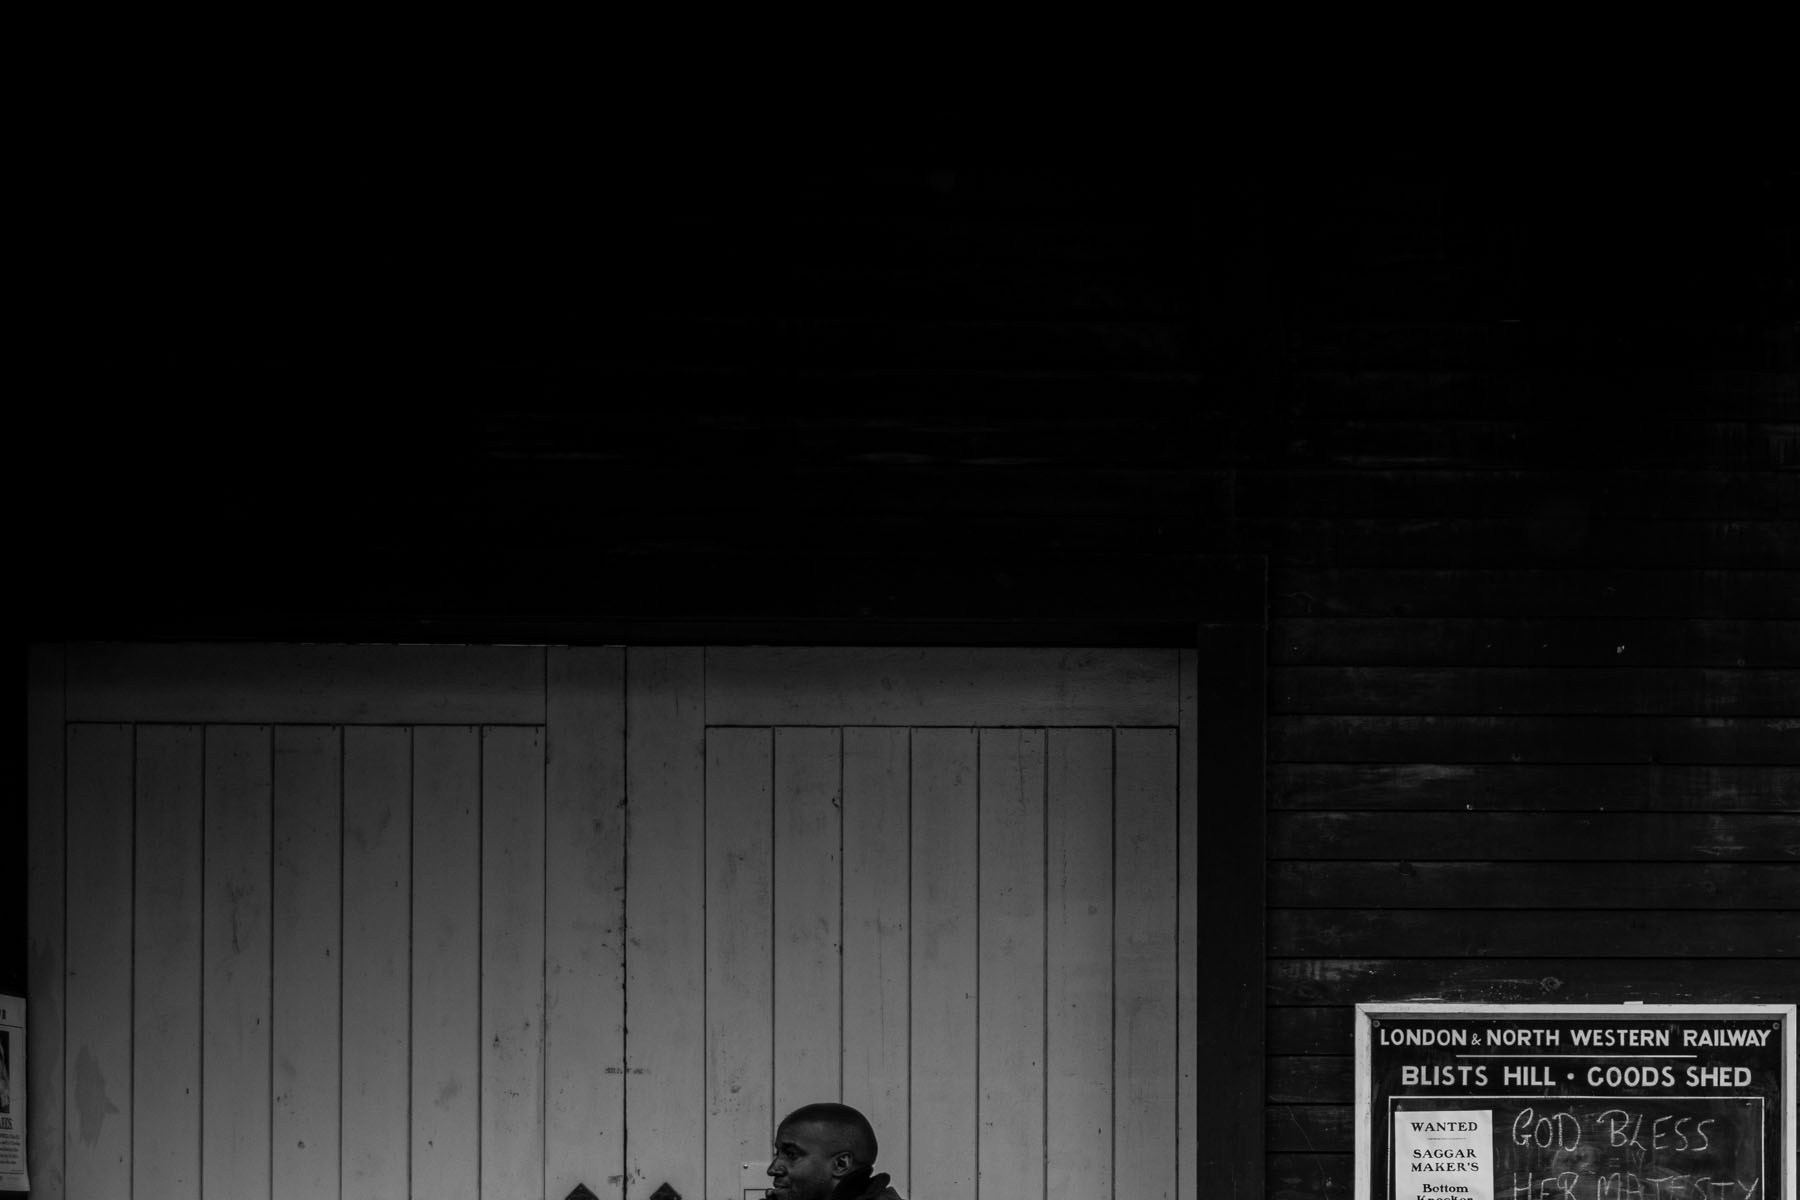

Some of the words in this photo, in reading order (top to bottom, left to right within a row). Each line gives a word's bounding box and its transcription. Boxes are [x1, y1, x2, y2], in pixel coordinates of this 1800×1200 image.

[1380, 1029, 1467, 1046] LONDON
[1471, 1033, 1481, 1046] &
[1487, 1029, 1560, 1046] NORTH
[1571, 1030, 1670, 1046] WESTERN
[1683, 1030, 1771, 1047] RAILWAY
[1401, 1066, 1488, 1086] BLISTS
[1504, 1066, 1556, 1086] HILL
[1587, 1066, 1675, 1086] GOODS
[1686, 1067, 1752, 1086] SHED
[1411, 1122, 1478, 1131] WANTED
[1512, 1108, 1581, 1151] GOD
[1597, 1110, 1714, 1150] BLESS
[1413, 1149, 1477, 1158] SAGGAR
[1411, 1162, 1479, 1172] MAKER'S
[1423, 1184, 1468, 1192] Bottom
